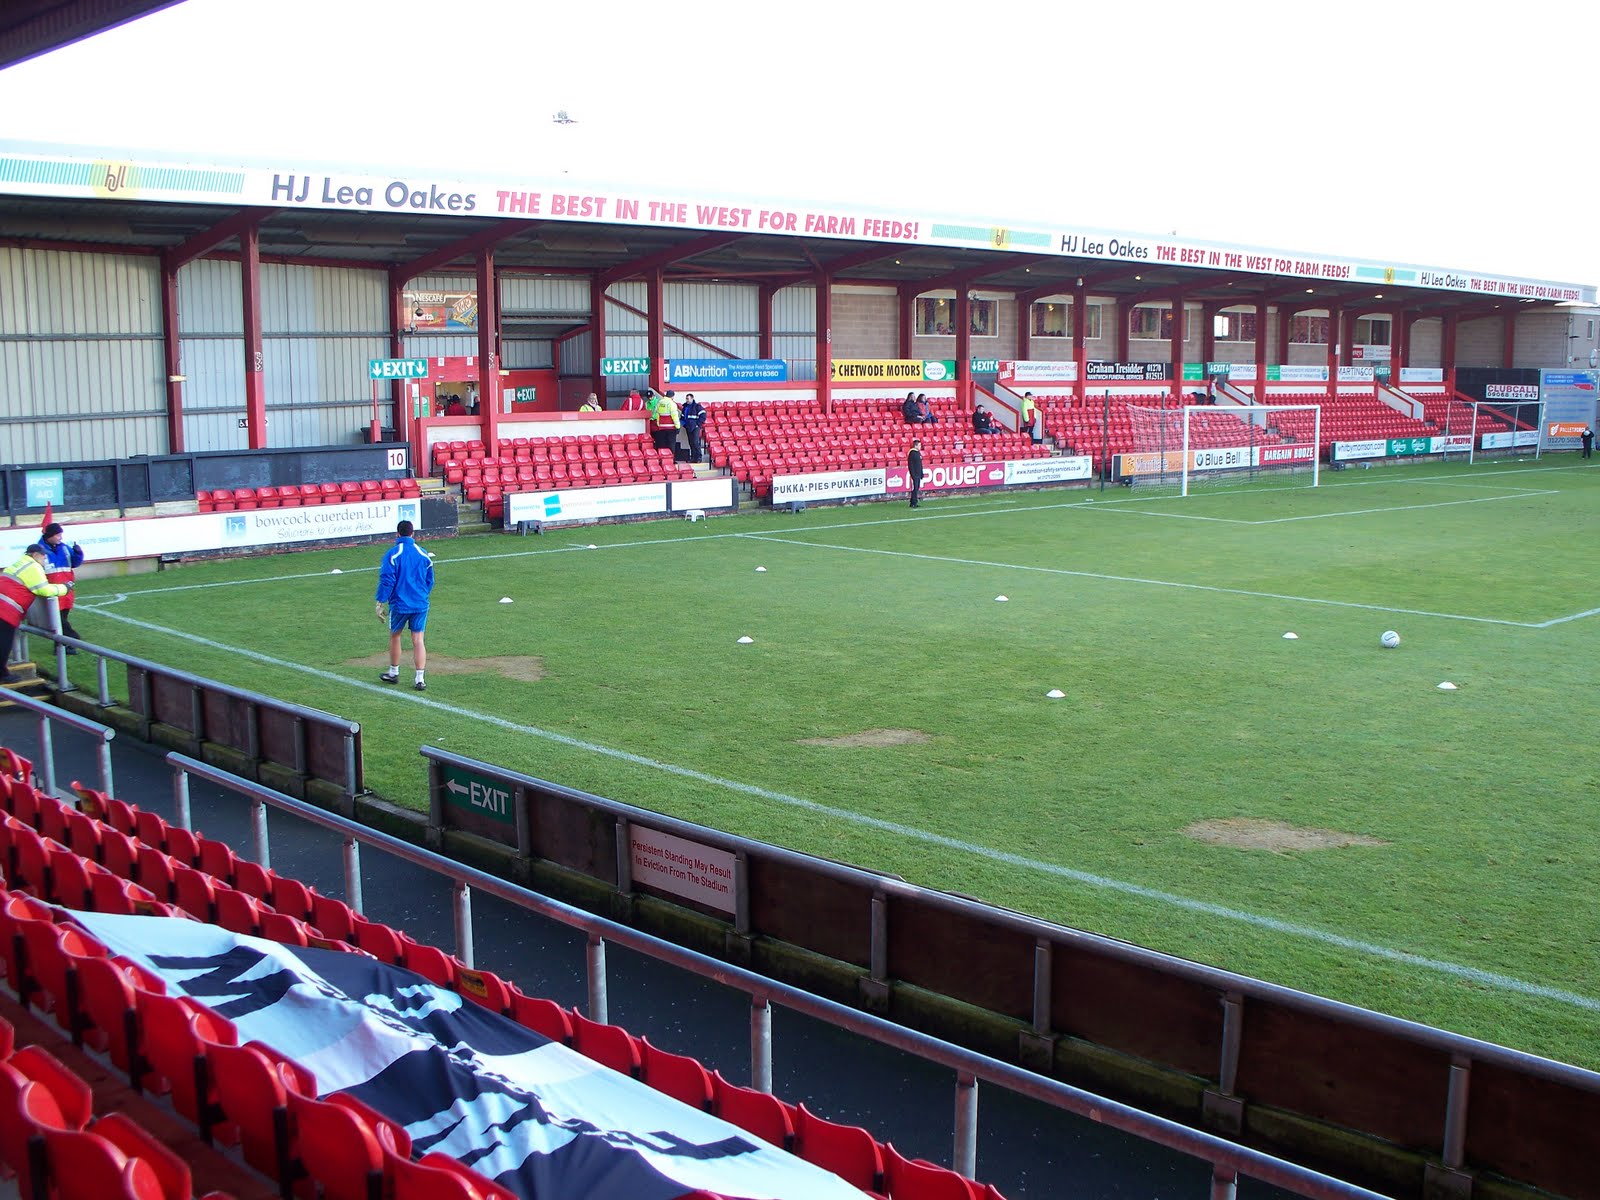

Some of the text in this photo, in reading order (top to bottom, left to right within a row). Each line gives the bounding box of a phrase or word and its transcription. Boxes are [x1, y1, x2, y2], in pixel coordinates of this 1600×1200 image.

[271, 174, 919, 240] HJ Lea Oakes THE BEST IN THE WEST FOR FARM FEEDS!
[1060, 234, 1350, 279] HJ Lea Oakes THE BEST IN THE WEST FOR FARM FEEDS!
[1420, 271, 1580, 300] HJ Lea Oakes THE BEST IN THE WEST FOR FARM FEEDS!
[383, 361, 414, 376] EXIT
[613, 360, 640, 373] EXIT
[674, 365, 728, 377] ABNutrition
[838, 364, 884, 377] CHETWODE
[886, 364, 921, 377] MOTORS
[976, 360, 994, 372] EXIT
[1087, 363, 1114, 374] Graham
[1115, 363, 1144, 374] Tresidder
[1213, 364, 1226, 373] EXIT
[522, 387, 536, 401] EXIT
[1487, 385, 1537, 394] CLUBCALL
[389, 452, 404, 467] 10
[1205, 453, 1223, 466] Blue
[1225, 451, 1240, 464] Bell
[1264, 448, 1292, 461] BARGAIN
[1294, 447, 1314, 460] BOOZE
[29, 477, 59, 487] FIRST
[36, 489, 54, 498] AID
[255, 505, 391, 528] bowcock cuerden LLP
[469, 780, 509, 815] EXIT
[631, 839, 731, 880] Persistent Standing May Result
[635, 855, 729, 894] In Eviction From The Stadium
